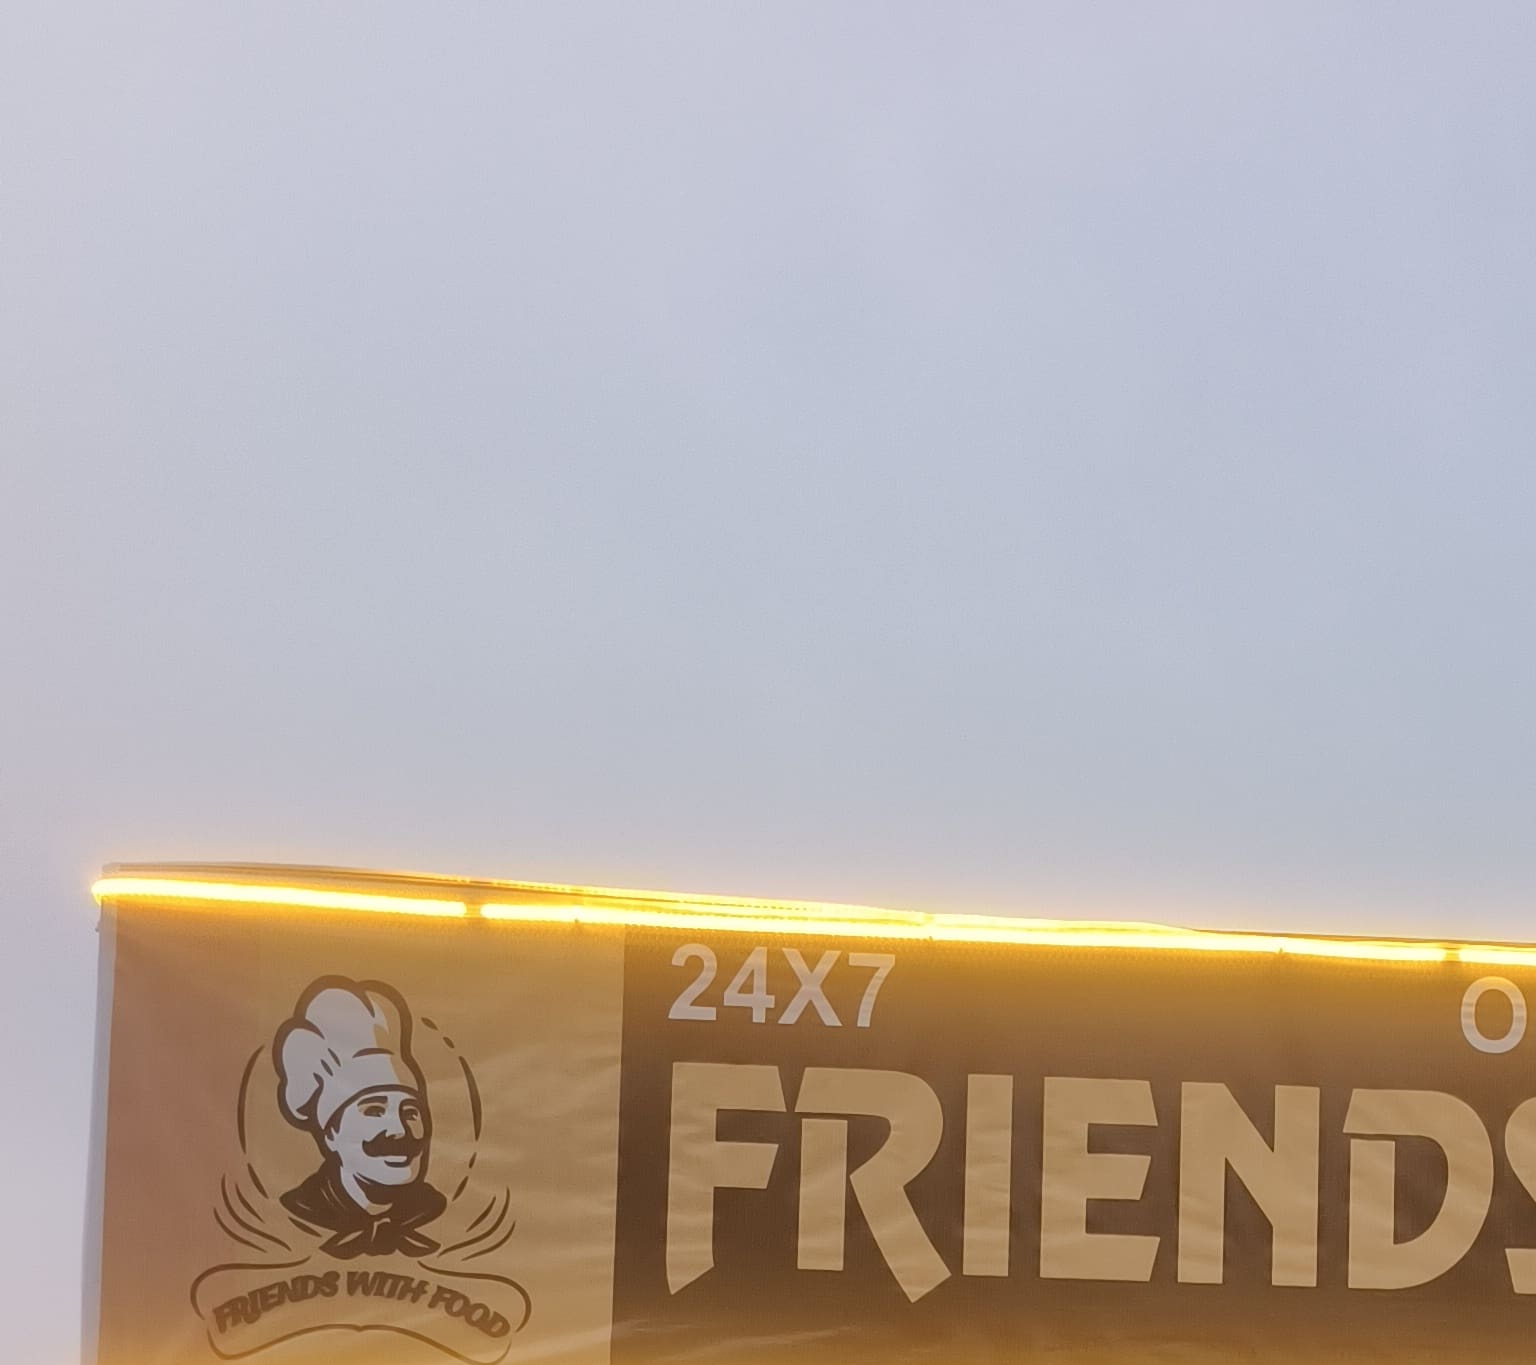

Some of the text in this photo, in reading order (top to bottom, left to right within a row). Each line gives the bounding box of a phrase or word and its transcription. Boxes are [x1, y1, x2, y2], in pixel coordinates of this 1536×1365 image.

[667, 943, 896, 1028] 24X7
[212, 1271, 511, 1338] FRIENDS WITH FOOD
